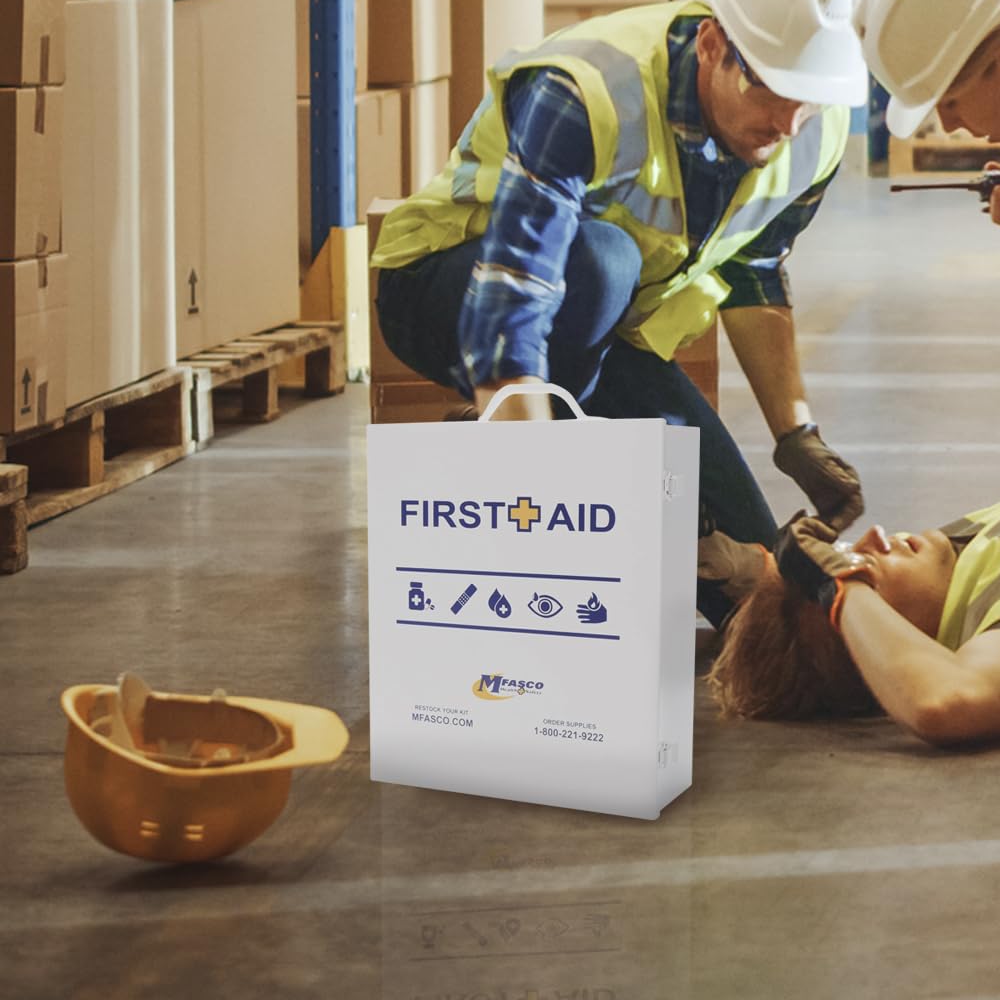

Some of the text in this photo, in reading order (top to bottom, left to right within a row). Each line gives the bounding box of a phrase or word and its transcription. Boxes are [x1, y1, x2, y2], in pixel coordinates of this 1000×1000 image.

[401, 500, 616, 532] FIRST AID
[479, 674, 544, 694] MFASCO
[414, 704, 442, 713] RESTOCK
[442, 707, 459, 715] YOUR
[411, 712, 474, 728] MFASCO.COM
[542, 718, 597, 731] ORDER SUPPLIES
[534, 726, 604, 743] 1-800-221-9222
